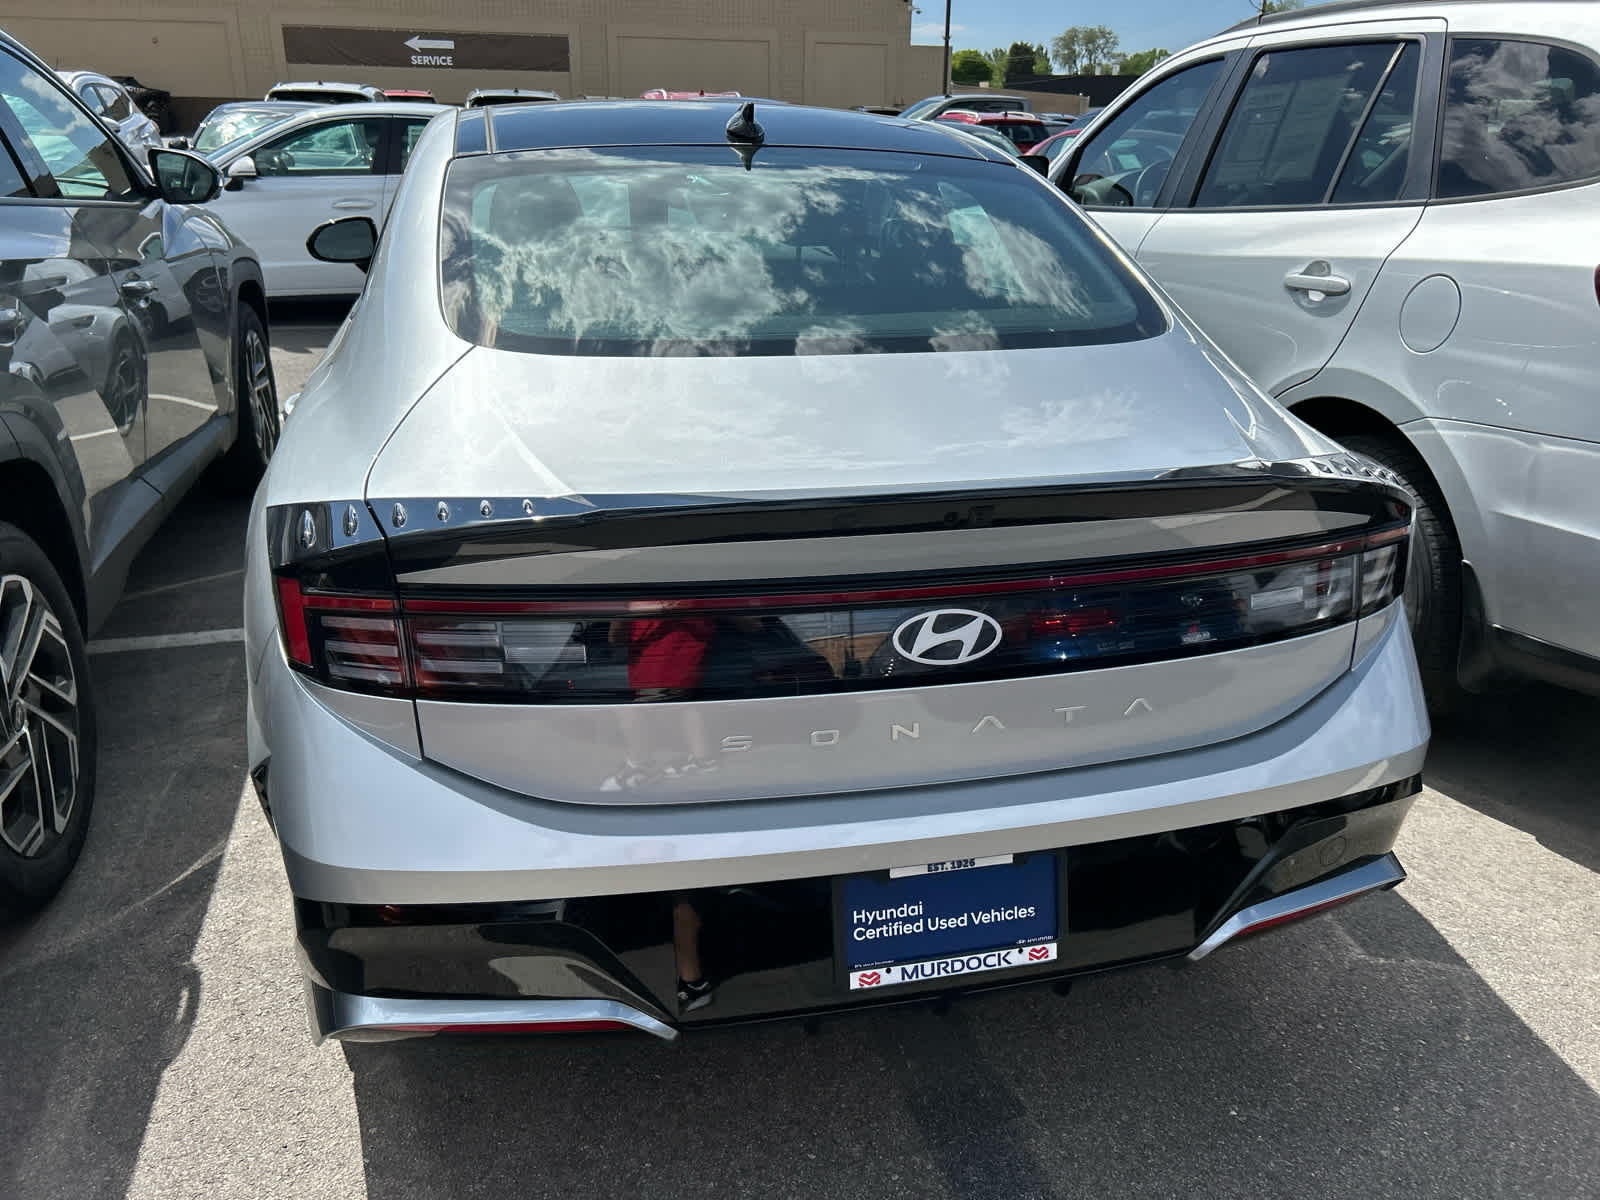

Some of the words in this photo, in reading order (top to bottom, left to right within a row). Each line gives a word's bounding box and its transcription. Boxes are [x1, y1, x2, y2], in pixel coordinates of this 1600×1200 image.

[410, 55, 454, 66] SERVICE
[720, 697, 1153, 752] SONATA
[927, 861, 948, 873] EST.
[852, 901, 923, 925] Hyundai
[853, 919, 923, 942] Certified
[927, 913, 967, 932] Used
[970, 906, 1036, 927] Vehicles
[901, 951, 1012, 981] MURDOCK
